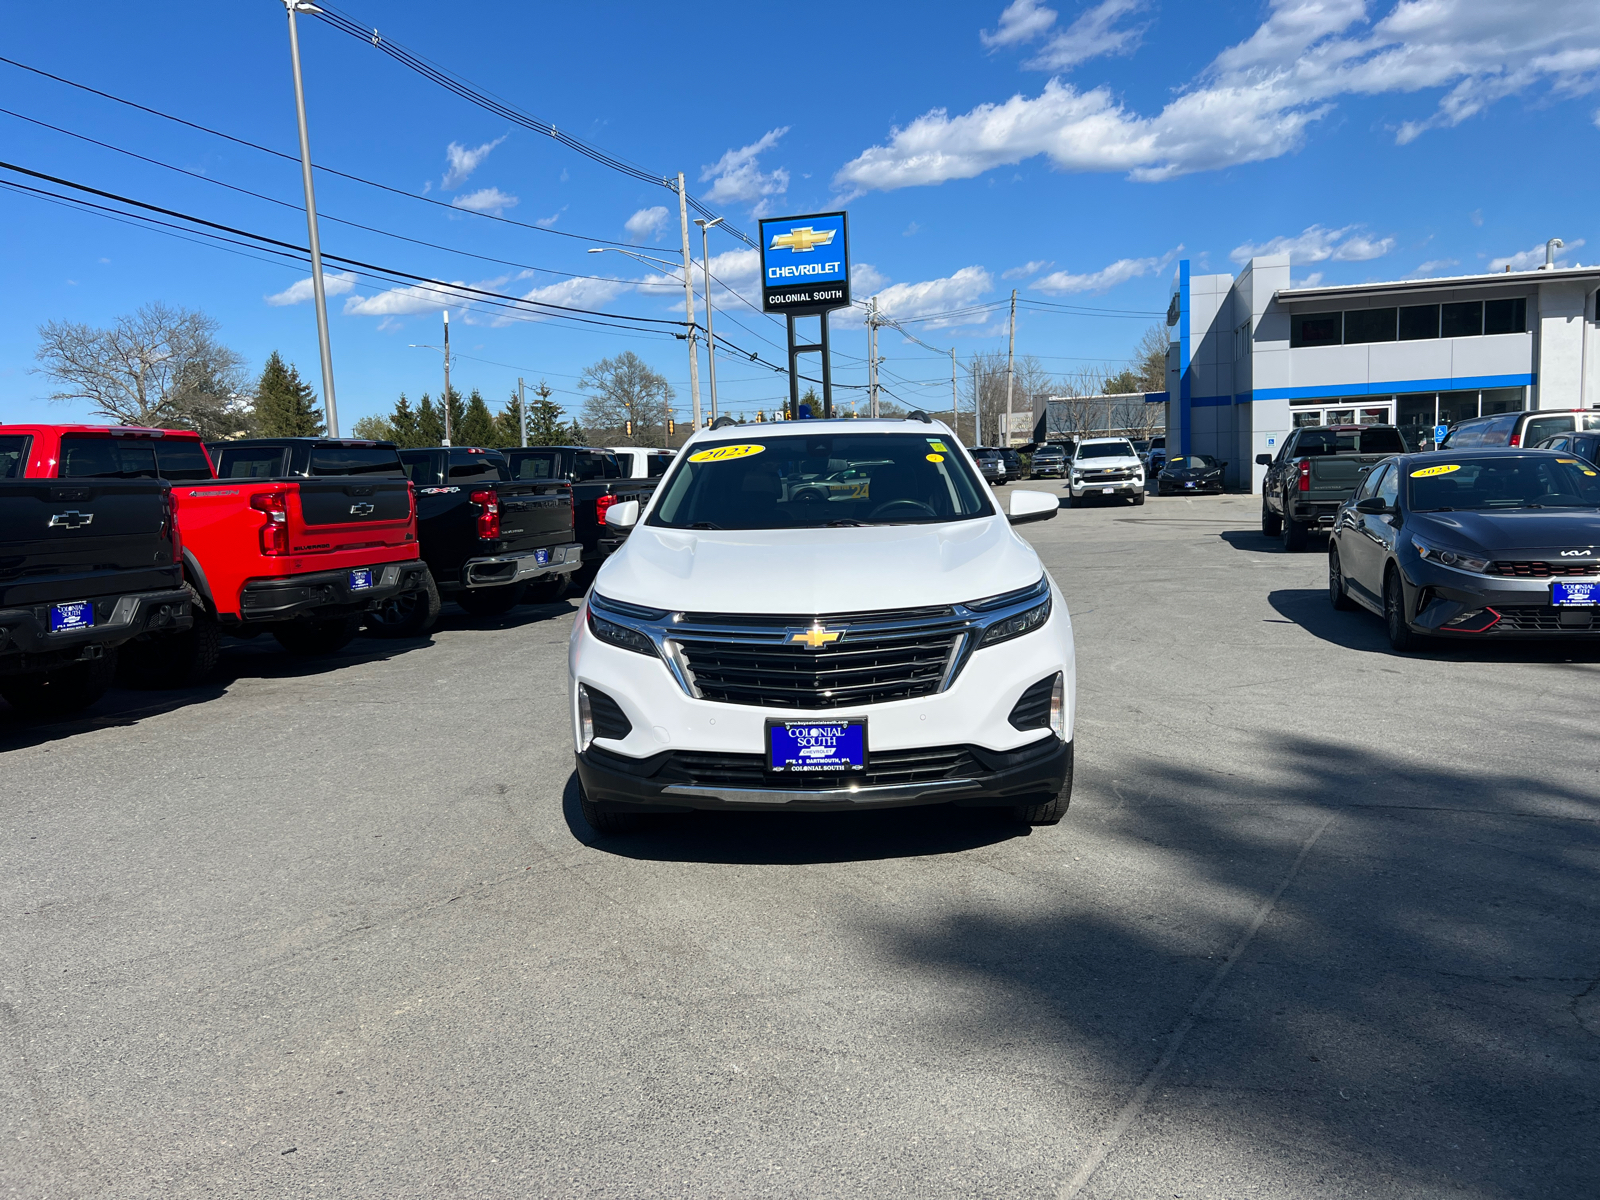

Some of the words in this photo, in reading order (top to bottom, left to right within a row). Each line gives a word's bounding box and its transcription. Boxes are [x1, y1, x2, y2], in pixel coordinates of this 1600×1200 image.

[768, 261, 841, 279] CHEVROLET
[768, 292, 811, 304] COLONIAL
[813, 290, 843, 300] SOUTH
[700, 446, 752, 461] 2023
[788, 727, 846, 738] COLONIAL
[797, 736, 837, 747] SOUTH
